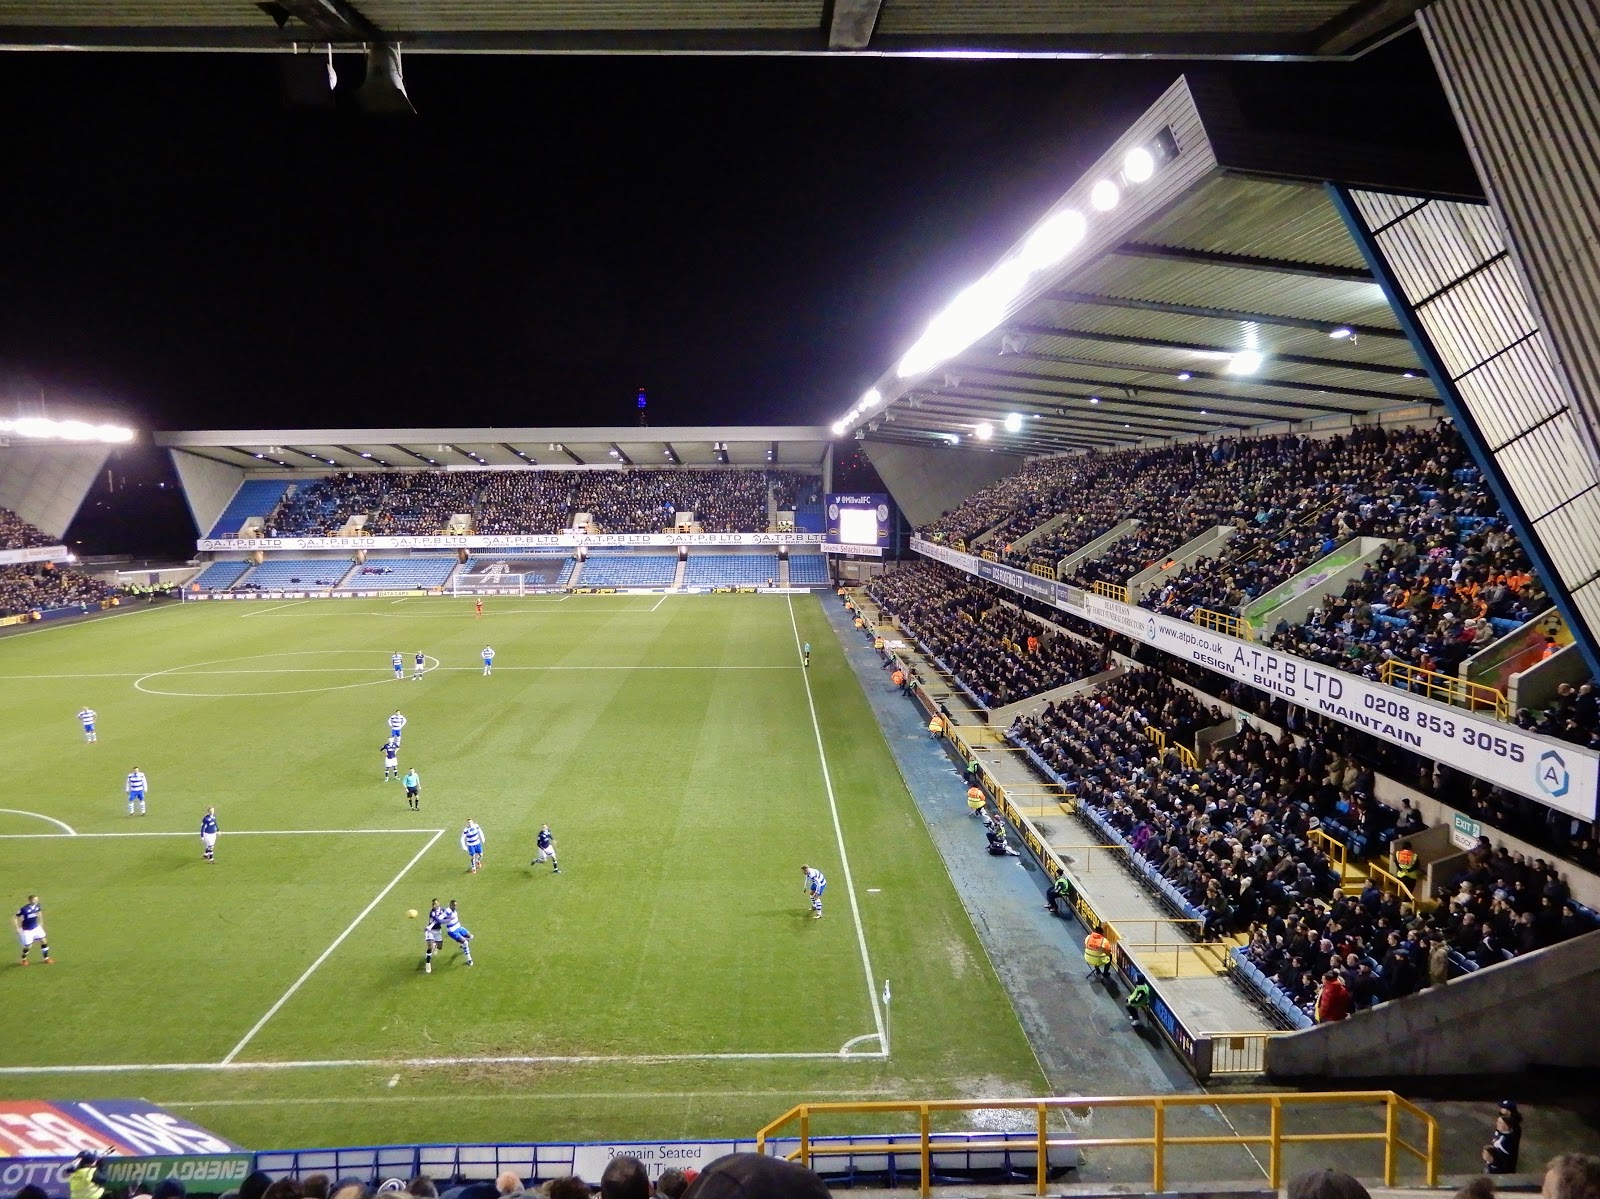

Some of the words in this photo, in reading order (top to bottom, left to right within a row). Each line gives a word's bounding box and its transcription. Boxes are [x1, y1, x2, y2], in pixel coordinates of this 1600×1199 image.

[840, 546, 860, 554] Selachii
[1016, 575, 1024, 588] LTD
[1158, 625, 1222, 655] www.atpb.co.uk
[1234, 646, 1296, 684] A.T.P.B
[1304, 668, 1343, 700] LTD
[1193, 651, 1235, 674] DESIGN
[1254, 674, 1296, 697] BUILD
[1319, 698, 1422, 748] MAINTAIN
[1364, 693, 1410, 722] 0208
[1416, 711, 1455, 738] 853
[1462, 728, 1525, 764] 3055
[1455, 818, 1472, 832] EXIT
[1455, 834, 1472, 848] BLOCK
[659, 1146, 701, 1159] Seated
[0, 1162, 72, 1185] OTTO
[166, 1160, 249, 1181] ENERGY
